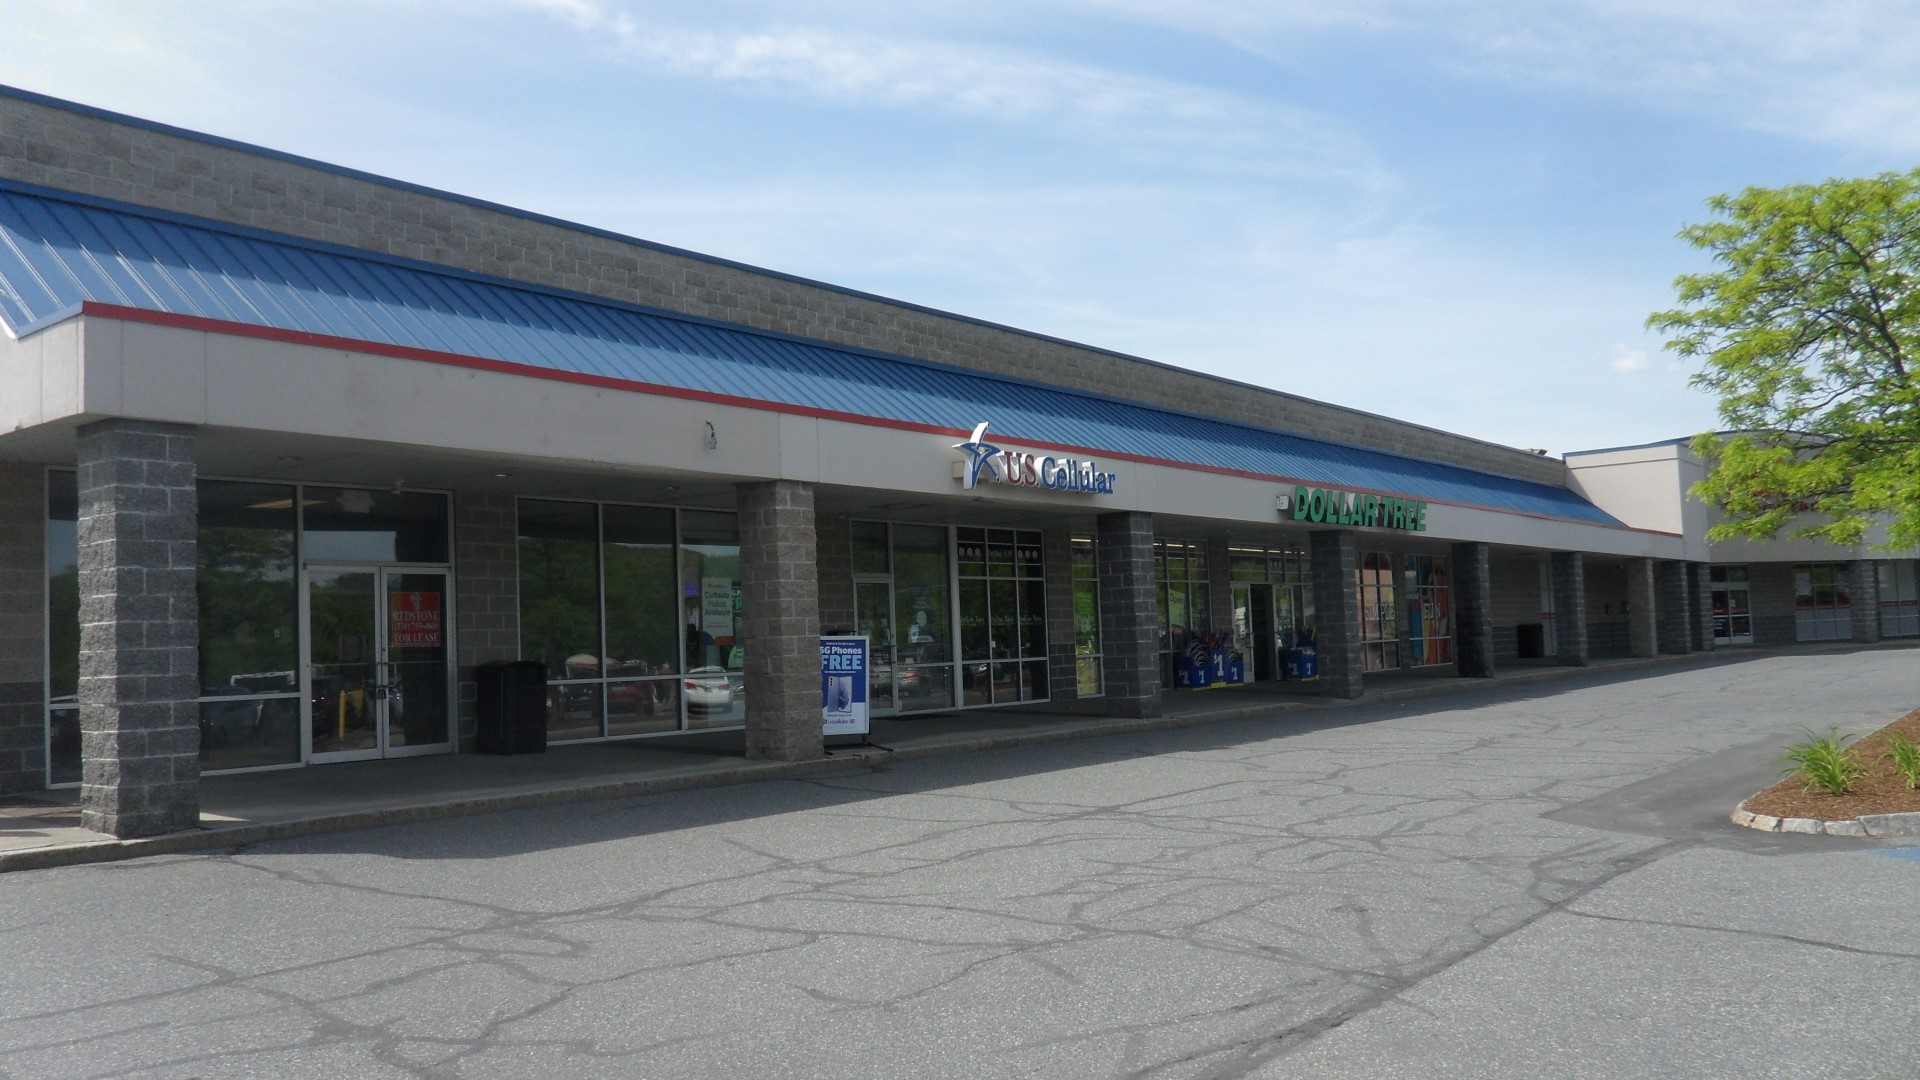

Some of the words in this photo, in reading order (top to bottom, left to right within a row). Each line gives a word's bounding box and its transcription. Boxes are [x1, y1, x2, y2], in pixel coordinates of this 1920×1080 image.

[1037, 455, 1117, 495] Cellular
[1293, 485, 1378, 528] DOLLAR
[1380, 495, 1428, 531] TREE
[392, 611, 440, 620] REDSTONE
[393, 632, 411, 642] FOR
[412, 632, 439, 642] LEASE
[819, 646, 831, 655] 5G
[831, 646, 862, 655] Phones
[821, 655, 862, 670] FREE
[1213, 653, 1225, 677] $1
